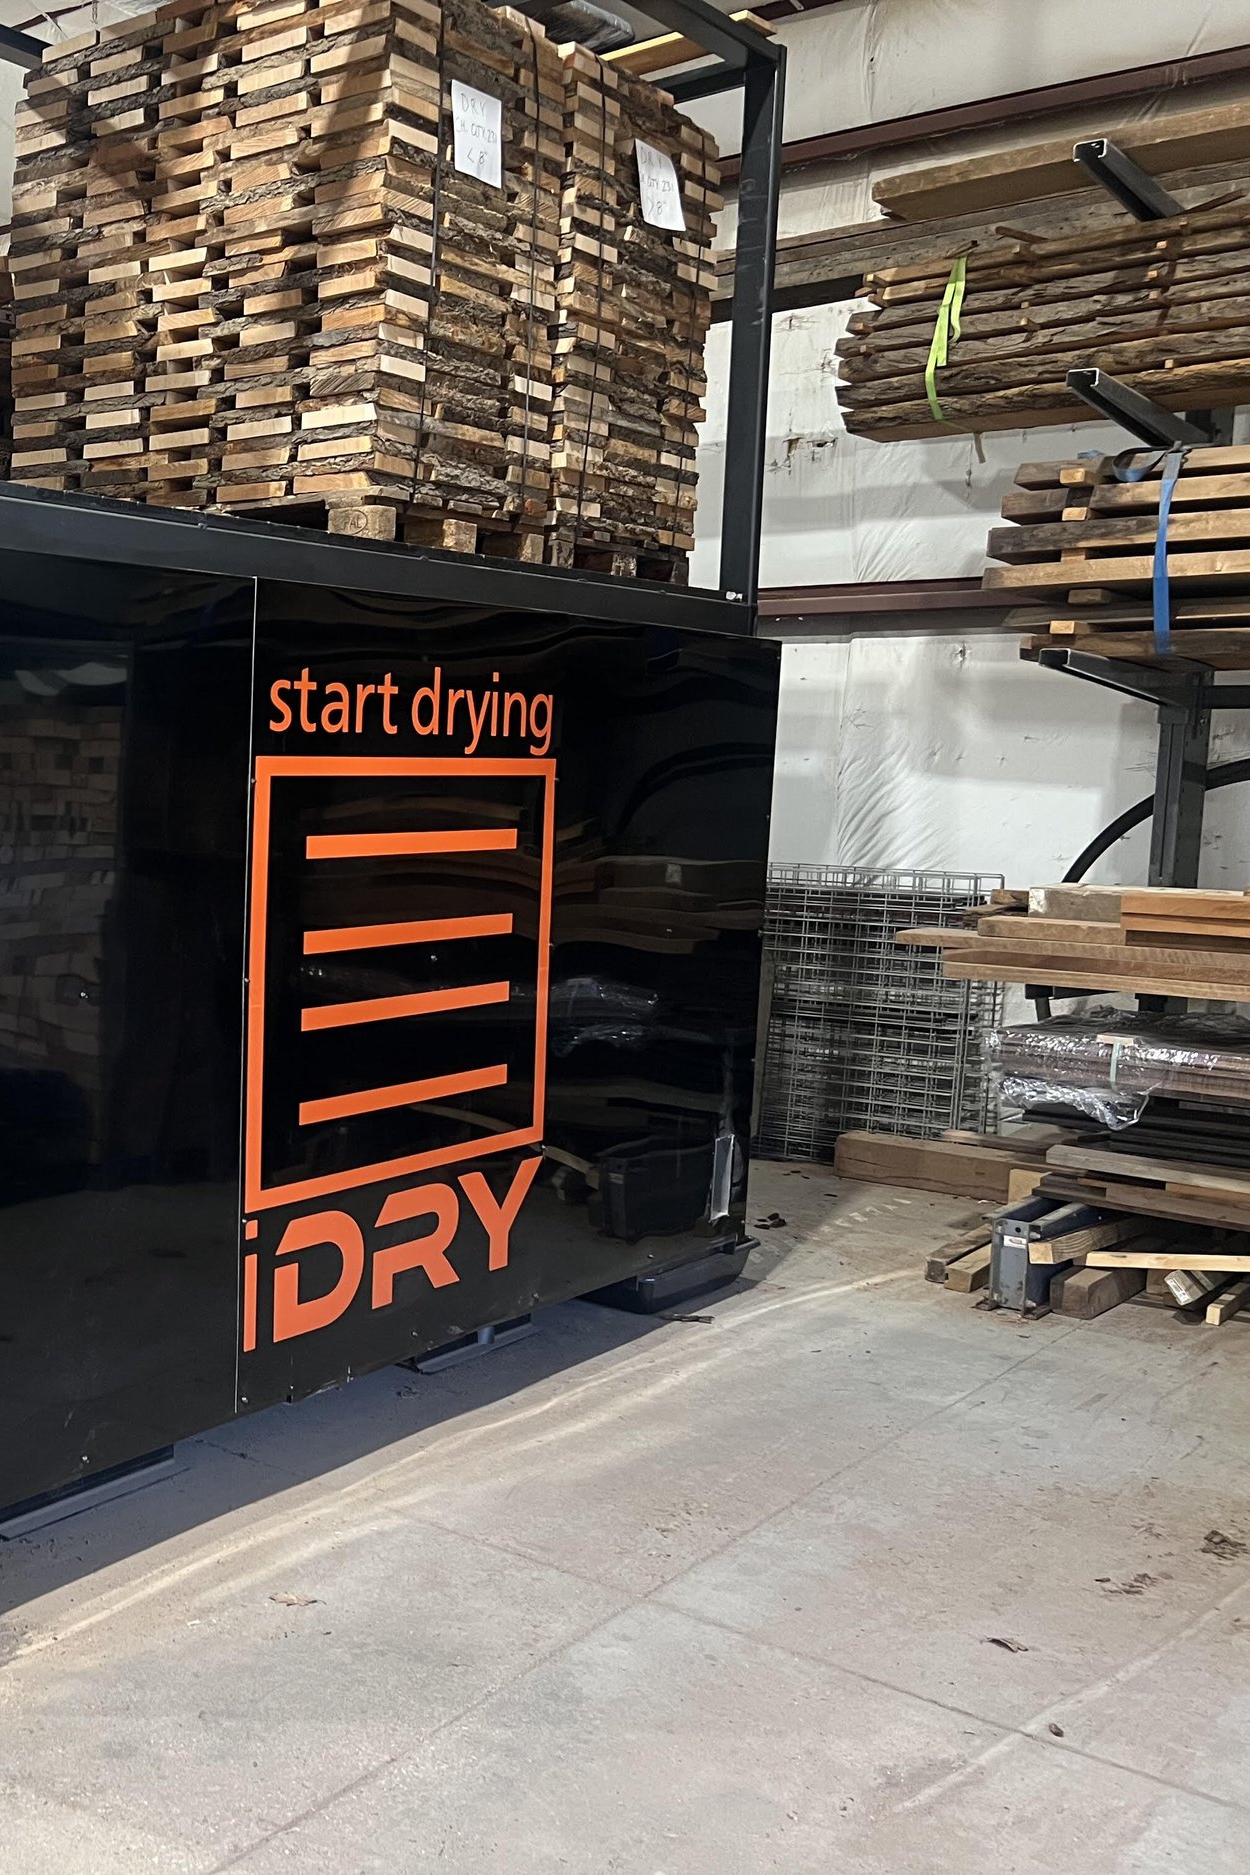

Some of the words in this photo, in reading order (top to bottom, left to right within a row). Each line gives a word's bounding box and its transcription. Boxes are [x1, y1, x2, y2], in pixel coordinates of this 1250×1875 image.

[460, 92, 486, 119] DRY
[269, 667, 399, 735] start
[411, 667, 553, 756] drying
[243, 1155, 543, 1353] iDRY
